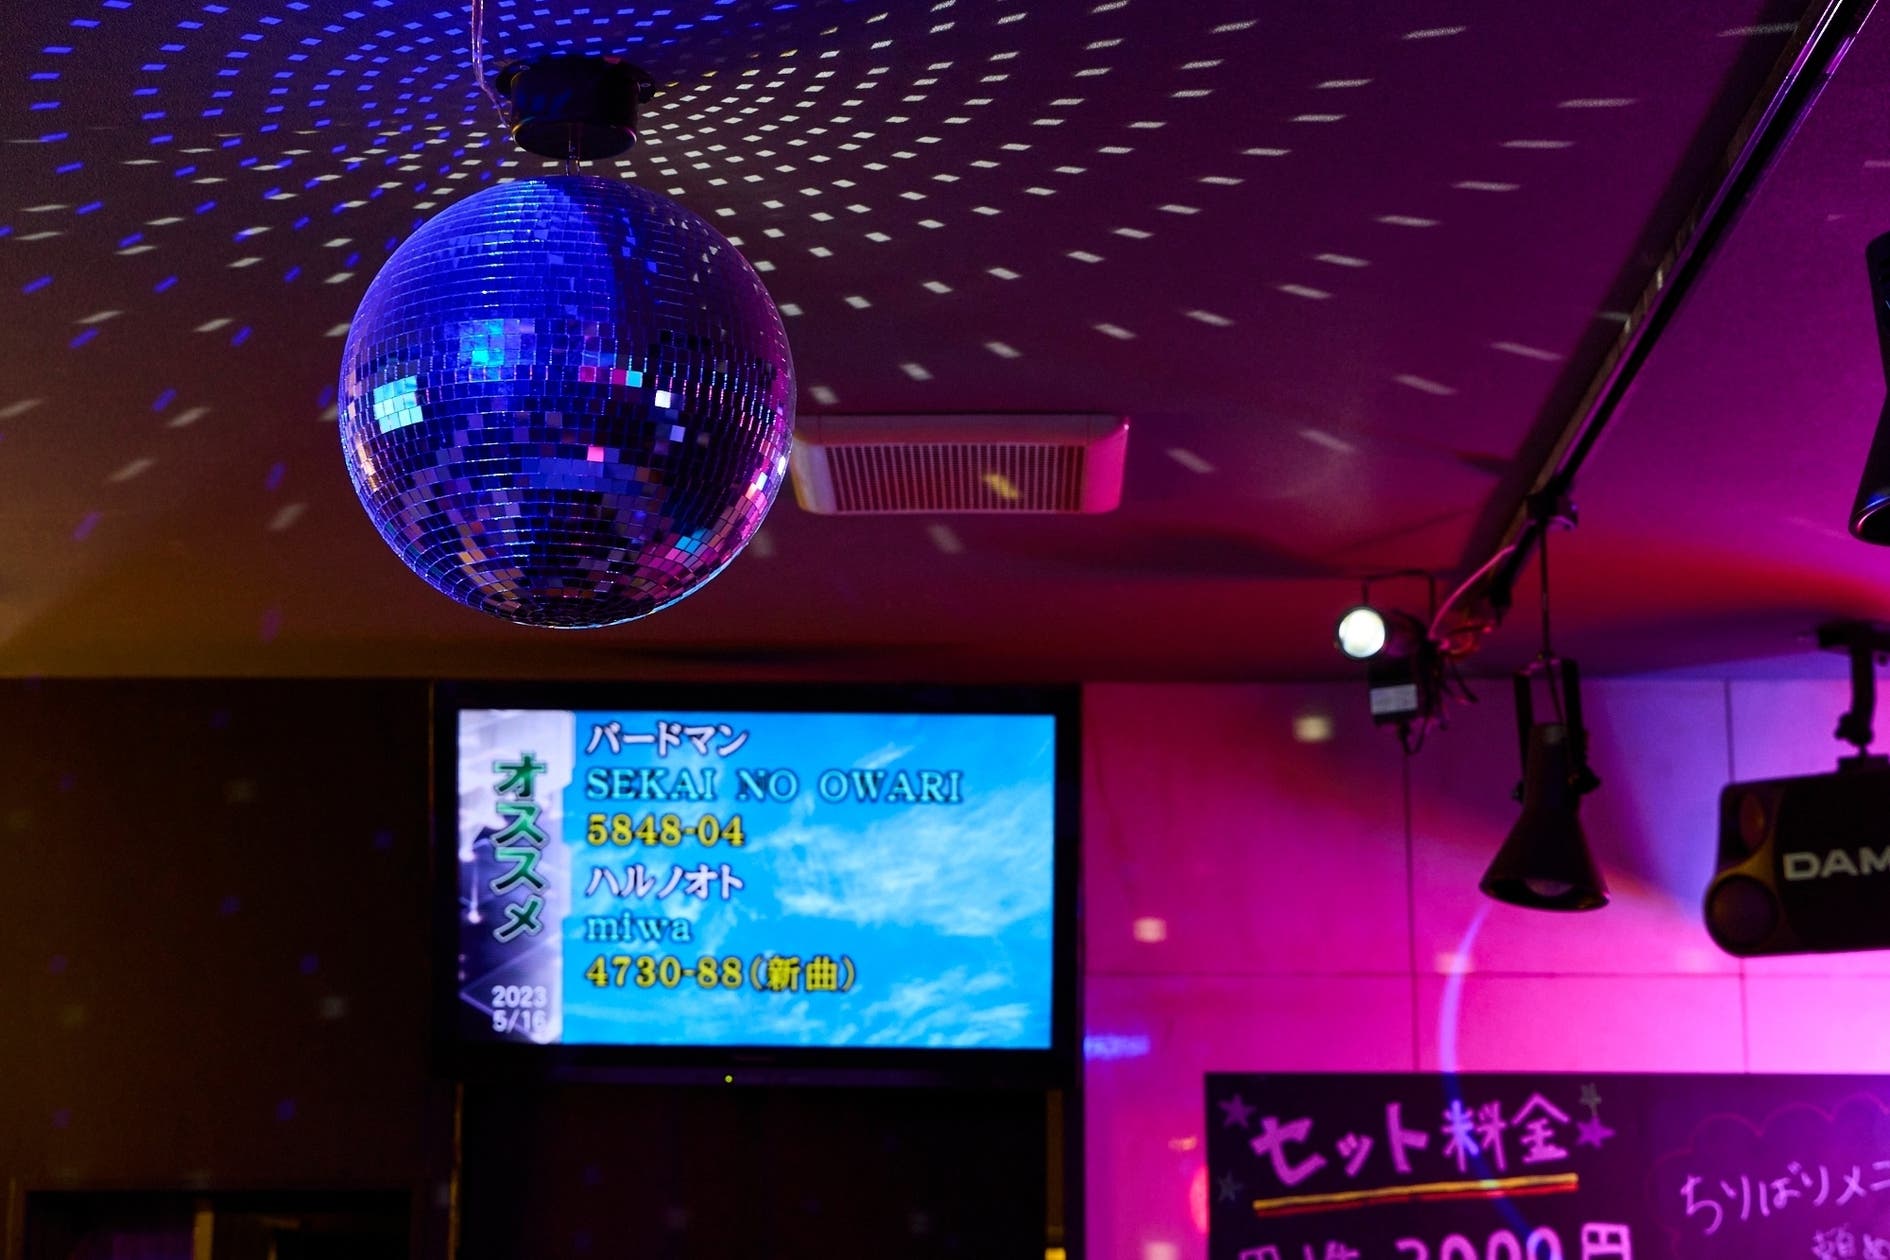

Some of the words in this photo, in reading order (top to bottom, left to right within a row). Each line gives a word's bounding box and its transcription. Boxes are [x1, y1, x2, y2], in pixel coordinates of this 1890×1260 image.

[585, 720, 750, 757] バードマン
[585, 767, 717, 801] SEKAI
[735, 768, 798, 802] NO
[818, 769, 964, 804] OWARI
[491, 751, 549, 943] オススメ
[586, 813, 745, 847] 5848-04
[585, 864, 744, 899] ハルノオト
[585, 911, 692, 942] miwa
[491, 985, 547, 1008] 2023
[492, 1008, 547, 1034] 5/16
[1250, 1092, 1571, 1187] セット料金
